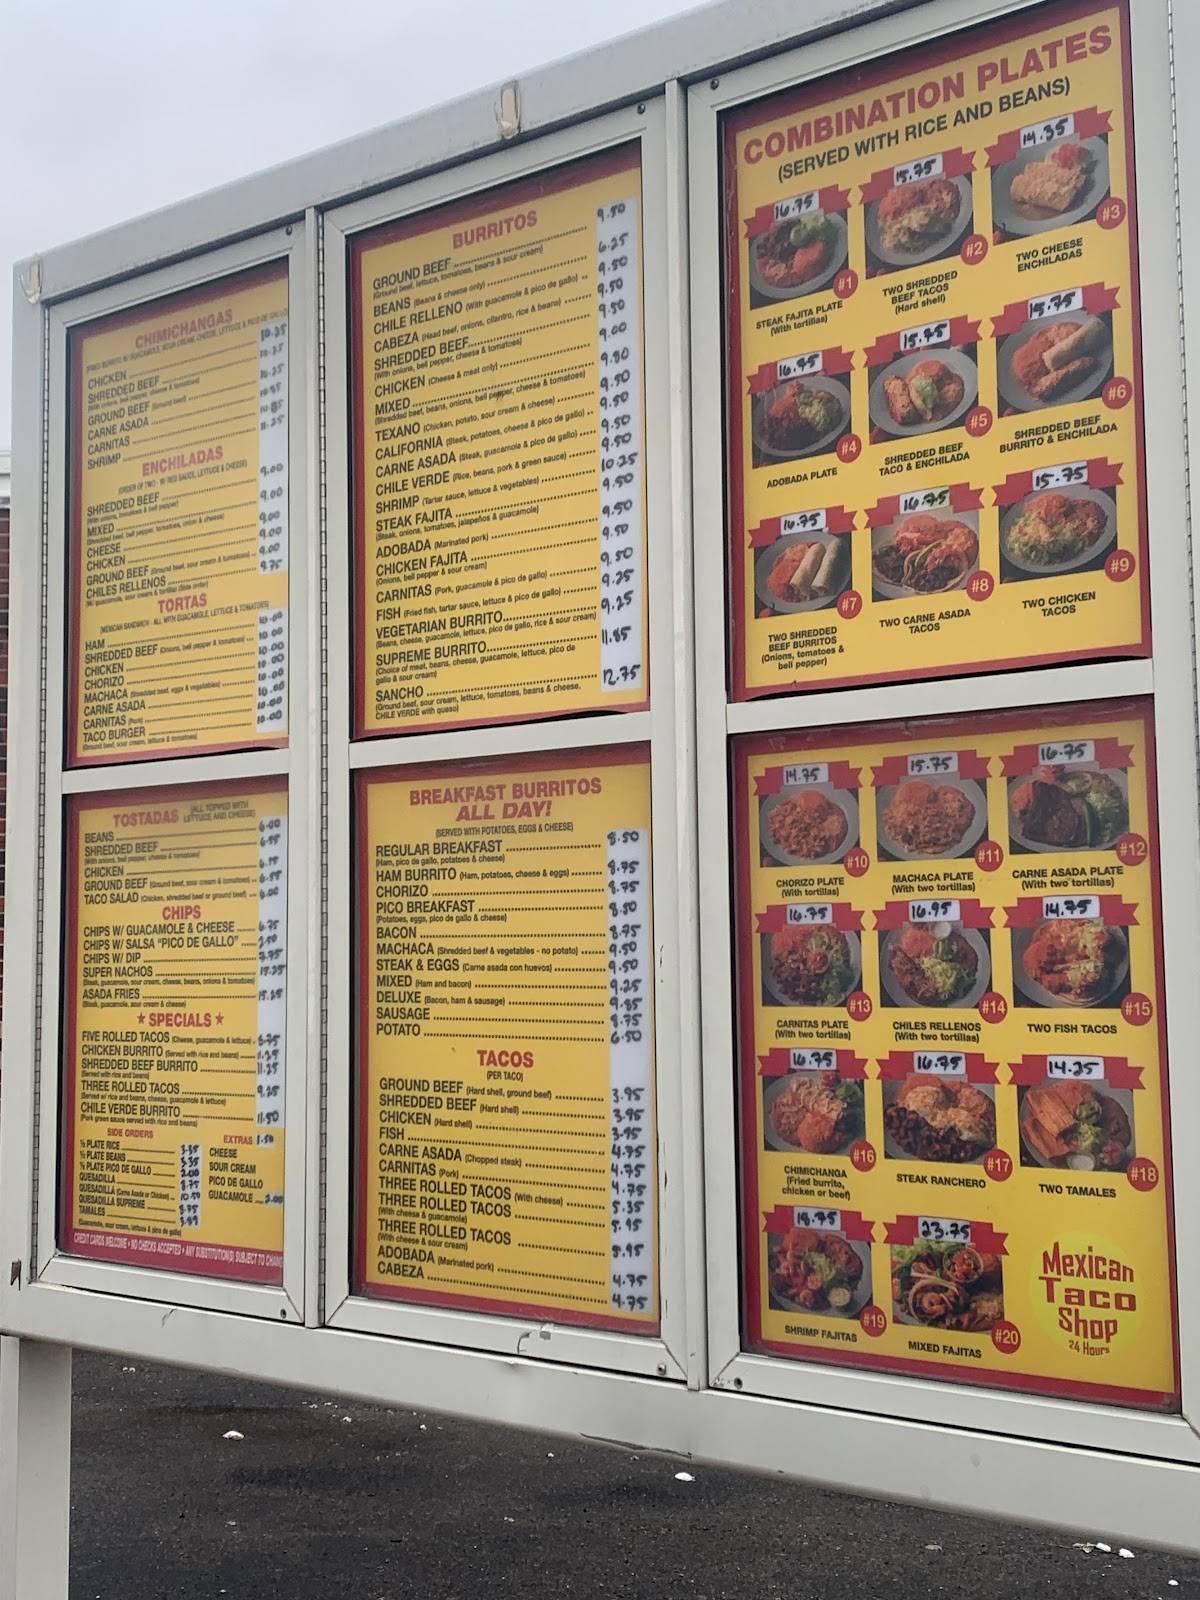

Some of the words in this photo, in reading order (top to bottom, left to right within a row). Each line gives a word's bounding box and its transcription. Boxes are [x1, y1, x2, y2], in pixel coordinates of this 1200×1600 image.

[743, 72, 965, 164] COMBINATION
[977, 25, 1112, 90] PLATES
[778, 148, 850, 183] (SERVED
[855, 132, 900, 157] WITH
[905, 119, 948, 142] RICE
[953, 102, 993, 126] AND
[998, 76, 1071, 113] BEANS)
[1022, 118, 1069, 146] 14.35
[597, 203, 626, 222] 9.50
[775, 194, 814, 218] 16.75
[1102, 204, 1122, 221] #3
[453, 210, 538, 249] BURRITOS
[966, 243, 983, 257] #2
[1016, 250, 1040, 263] TWO
[1042, 238, 1084, 256] CHEESE
[1017, 249, 1082, 272] ENCHILADAS
[373, 267, 421, 290] GROUND
[423, 257, 451, 276] BEEF
[882, 284, 904, 297] TWO
[906, 271, 958, 292] SHREDDED
[891, 293, 915, 304] BEEF
[918, 283, 949, 298] TACOS
[373, 297, 411, 317] BEANS
[756, 315, 783, 329] STEAK
[785, 308, 813, 322] FAJITA
[815, 300, 843, 315] PLATE
[373, 316, 407, 335] CHILE
[410, 301, 463, 325] RELLENO
[135, 309, 233, 349] CHIMICHANGAS
[374, 332, 419, 353] CABEZA
[374, 346, 436, 371] SHREDDED
[440, 337, 470, 355] BEEF
[88, 370, 127, 389] CHICKEN
[374, 375, 426, 398] CHICKEN
[1109, 385, 1126, 399] #6
[375, 398, 411, 415] MIXED
[971, 414, 988, 428] #5
[1015, 422, 1071, 440] SHREDDED
[1074, 415, 1101, 428] BEEF
[375, 422, 421, 442] TEXANO
[1000, 437, 1045, 453] BURRITO
[1047, 433, 1054, 444] &
[1057, 423, 1118, 441] ENCHILADA
[375, 437, 443, 460] CALIFORNIA
[142, 446, 223, 477] ENCHILADAS
[375, 459, 415, 478] CARNE
[417, 451, 457, 469] ASADA
[766, 474, 809, 488] ADOBADA
[810, 467, 838, 480] PLATE
[1035, 465, 1088, 488] 15.75
[375, 495, 420, 514] SHRIMP
[375, 517, 412, 532] STEAK
[414, 508, 453, 524] FAJITA
[375, 539, 431, 559] ADOBADA
[376, 560, 427, 576] CHICKEN
[430, 552, 468, 567] FAJITA
[1111, 558, 1129, 573] #9
[971, 579, 989, 592] #8
[158, 593, 208, 614] TORTAS
[1022, 599, 1046, 608] TWO
[1048, 591, 1096, 606] CHICKEN
[376, 607, 401, 621] FISH
[879, 617, 901, 628] TWO
[903, 613, 936, 624] CARNE
[938, 608, 971, 620] ASADA
[1041, 604, 1076, 617] TACOS
[909, 622, 940, 635] TACOS
[85, 639, 105, 651] HAM
[376, 647, 431, 666] SUPREME
[435, 641, 487, 657] BURRITO
[84, 676, 124, 690] CHORIZO
[603, 665, 641, 686] 12.75
[376, 685, 424, 702] SANCHO
[83, 729, 106, 743] TACO
[108, 726, 145, 739] BURGER
[911, 756, 953, 772] 15.75
[785, 768, 820, 783] 14.75
[409, 784, 506, 805] BREAKFAST
[512, 777, 601, 799] BURRITOS
[113, 809, 179, 828] TOSTADAS
[456, 803, 495, 821] ALL
[502, 801, 552, 820] DAY!
[1120, 842, 1146, 856] #12
[376, 870, 402, 882] HAM
[405, 868, 457, 880] BURRITO
[459, 871, 479, 880] (Ham,
[481, 870, 513, 880] potatoes,
[515, 869, 540, 878] cheese
[542, 869, 547, 877] &
[549, 868, 569, 878] eggs)
[893, 874, 942, 883] MACHACA
[943, 872, 973, 881] PLATE
[1012, 868, 1048, 878] CARNE
[1050, 867, 1088, 877] ASADA
[1090, 866, 1124, 876] PLATE
[776, 879, 816, 887] CHORIZO
[817, 877, 844, 885] PLATE
[1022, 879, 1047, 890] (With
[1050, 880, 1069, 888] two
[1071, 878, 1114, 888] tortillas)
[376, 885, 428, 898] CHORIZO
[163, 905, 201, 920] CHIPS
[911, 901, 952, 918] 16.95
[84, 926, 110, 937] CHIPS
[113, 925, 124, 935] W/
[126, 923, 184, 936] GUACAMOLE
[187, 923, 194, 933] &
[197, 921, 235, 933] CHEESE
[376, 926, 417, 939] BACON
[376, 943, 434, 955] MACHACA
[83, 967, 112, 977] SUPER
[115, 966, 153, 976] NACHOS
[376, 959, 413, 971] STEAK
[416, 959, 424, 970] &
[427, 958, 459, 970] EGGS
[376, 975, 412, 987] MIXED
[376, 992, 421, 1003] DELUXE
[376, 1007, 430, 1020] SAUSAGE
[1124, 1002, 1150, 1016] #15
[150, 1012, 211, 1027] SPECIALS
[893, 1022, 927, 1031] CHILES
[930, 1023, 981, 1031] RELLENOS
[82, 1031, 100, 1042] FIVE
[102, 1031, 138, 1043] ROLLED
[140, 1032, 169, 1044] TACOS
[376, 1023, 420, 1036] POTATO
[1028, 1024, 1052, 1033] TWO
[1054, 1024, 1078, 1033] FISH
[1080, 1024, 1117, 1034] TACOS
[477, 1050, 534, 1068] TACOS
[487, 1070, 502, 1081] (PER
[503, 1071, 524, 1082] TACO)
[1048, 1061, 1100, 1075] 14.25
[896, 1173, 929, 1184] STEAK
[931, 1177, 986, 1189] RANCHERO
[379, 1176, 417, 1191] THREE
[420, 1180, 467, 1196] ROLLED
[470, 1184, 511, 1200] TACOS
[514, 1191, 533, 1203] (With
[535, 1195, 563, 1206] cheese)
[1039, 1184, 1063, 1194] TWO
[1066, 1185, 1116, 1198] TAMALES
[921, 1222, 970, 1238] 23.75
[1042, 1241, 1134, 1282] Mexican
[1039, 1276, 1136, 1312] Taco
[1058, 1307, 1117, 1342] Shop
[908, 1341, 939, 1353] MIXED
[942, 1345, 982, 1359] FAJITAS
[1069, 1340, 1081, 1352] 24
[1083, 1342, 1109, 1356] Hours
